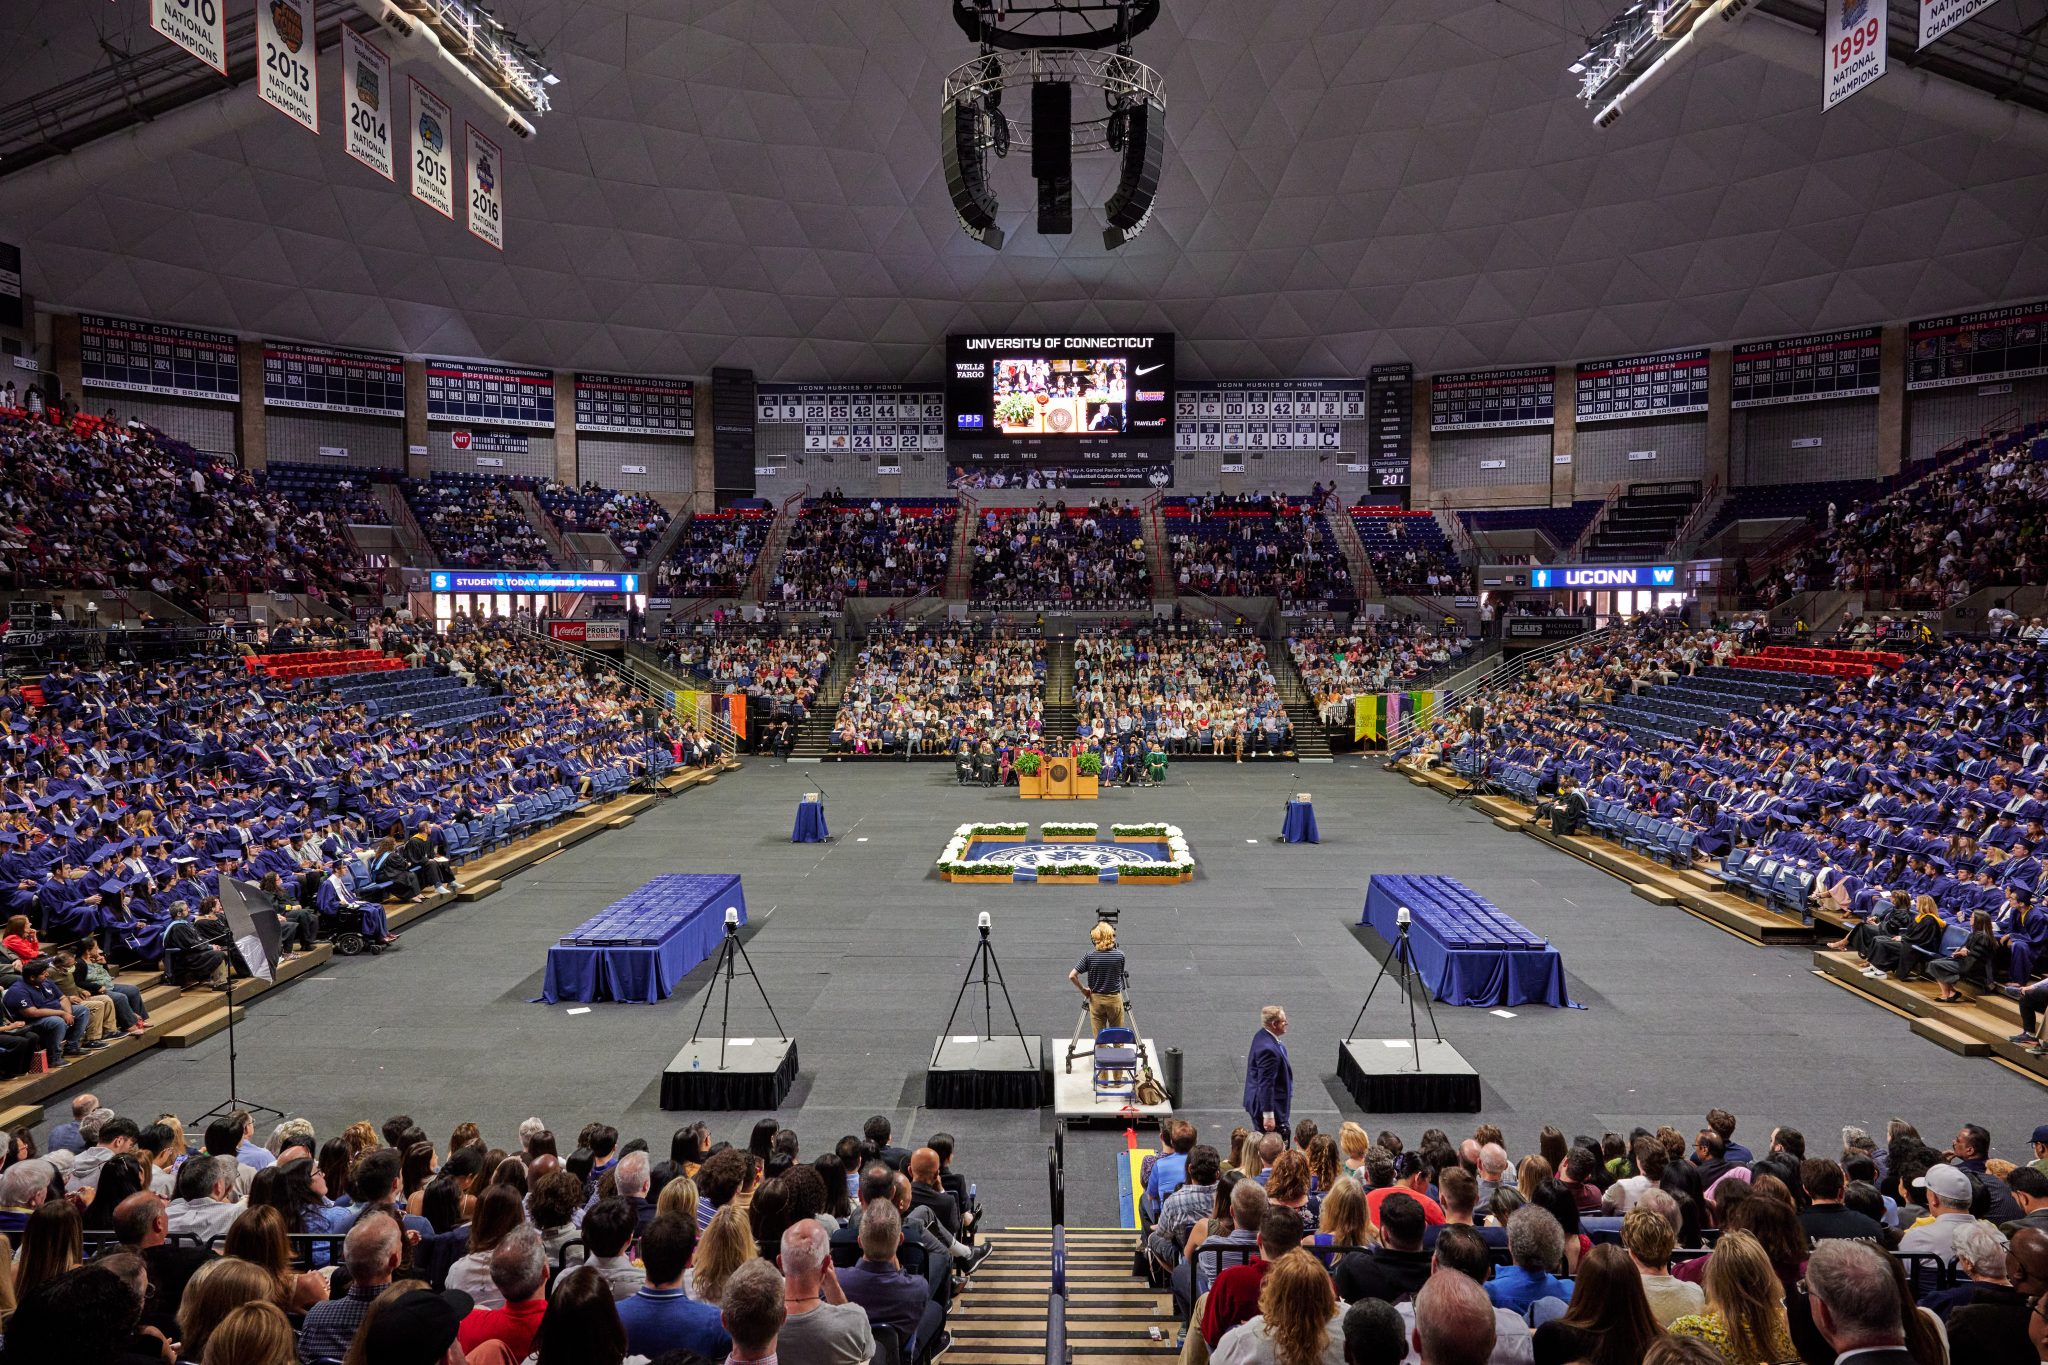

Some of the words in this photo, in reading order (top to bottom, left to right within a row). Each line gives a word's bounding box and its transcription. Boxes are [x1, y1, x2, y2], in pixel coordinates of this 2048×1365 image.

[164, 2, 214, 45] NATIONAL
[160, 18, 218, 64] CHAMPIONS
[1831, 18, 1879, 70] 1999
[266, 42, 310, 92] 2013
[1833, 51, 1876, 86] NATIONAL
[1829, 64, 1879, 103] CHAMPIONS
[269, 74, 309, 108] NATIONAL
[266, 87, 312, 125] CHAMPIONS
[351, 102, 387, 145] 2014
[353, 130, 385, 159] NATIONAL
[351, 143, 389, 173] CHAMPIONS
[417, 150, 447, 186] 2015
[418, 174, 446, 199] NATIONAL
[416, 187, 449, 213] CHAMPIONS
[472, 189, 498, 221] 2016
[473, 212, 498, 234] NATIONAL
[472, 222, 500, 246] CHAMPIONS
[82, 316, 104, 326] BIG
[112, 320, 145, 332] EAST
[153, 326, 234, 344] CONFERENCE
[1918, 318, 1953, 330] NCAA
[1960, 323, 1989, 332] FINAL
[1994, 318, 2022, 327] FOUR
[966, 338, 1042, 350] UNIVERSITY
[1044, 338, 1062, 349] OF
[1064, 337, 1154, 349] CONNECTICUT
[1741, 343, 1772, 353] NCAA
[1778, 330, 1873, 349] CHAMPIONSHIP
[26, 360, 38, 370] 212
[276, 351, 337, 365] TOURNAMENT
[341, 357, 391, 371] CHAMPIONS
[956, 363, 985, 371] WELLS
[1584, 361, 1612, 370] NCAA
[1618, 352, 1702, 367] CHAMPIONSHIP
[431, 362, 464, 370] NATIONAL
[467, 365, 504, 374] INVITATION
[506, 369, 548, 378] TOURNAMENT
[957, 371, 985, 379] FARGO
[1440, 374, 1466, 383] NCAA
[1470, 369, 1548, 381] CHAMPIONSHIP
[1609, 367, 1635, 375] SWEET
[462, 372, 520, 383] APPEARANCES
[582, 375, 609, 384] NCAA
[613, 377, 687, 388] CHAMPIONSHIP
[1911, 376, 1972, 389] CONNECTICUT
[85, 379, 148, 392] CONNECTICUT
[182, 390, 235, 401] BASKETBALL
[1735, 396, 1790, 407] CONNECTICUT
[1821, 388, 1876, 399] BASKETBALL
[268, 399, 324, 409] CONNECTICUT
[353, 406, 401, 416] BASKETBALL
[763, 407, 774, 418] C
[789, 407, 796, 418] 9
[807, 406, 824, 418] 22
[830, 406, 848, 418] 25
[854, 406, 871, 418] 42
[877, 405, 895, 417] 44
[924, 405, 942, 417] 42
[1179, 404, 1194, 415] 52
[1226, 404, 1242, 415] 00
[1251, 404, 1265, 415] 13
[1274, 403, 1290, 415] 42
[1300, 403, 1311, 415] 34
[1324, 403, 1335, 415] 32
[1348, 403, 1359, 414] 50
[1580, 412, 1628, 421] CONNECTICUT
[1656, 405, 1705, 414] BASKETBALL
[431, 414, 480, 422] CONNECTICUT
[958, 414, 981, 423] CBS
[812, 437, 820, 447] 2
[854, 436, 871, 448] 24
[879, 436, 893, 448] 13
[902, 436, 918, 448] 22
[1182, 434, 1191, 446] 15
[1205, 434, 1215, 446] 22
[1252, 434, 1263, 446] 42
[1276, 434, 1287, 446] 13
[1303, 434, 1308, 445] 3
[1323, 432, 1335, 446] C
[1382, 474, 1403, 485] 2:01
[457, 578, 504, 587] STUDENTS
[506, 578, 537, 587] TODAY.
[539, 578, 575, 587] HUSKIES
[576, 578, 617, 587] FOREVER.
[1566, 570, 1637, 585] UCONN
[8, 636, 20, 644] SEC
[24, 633, 43, 645] 109
[207, 629, 222, 639] 109
[1897, 630, 1910, 638] 120
